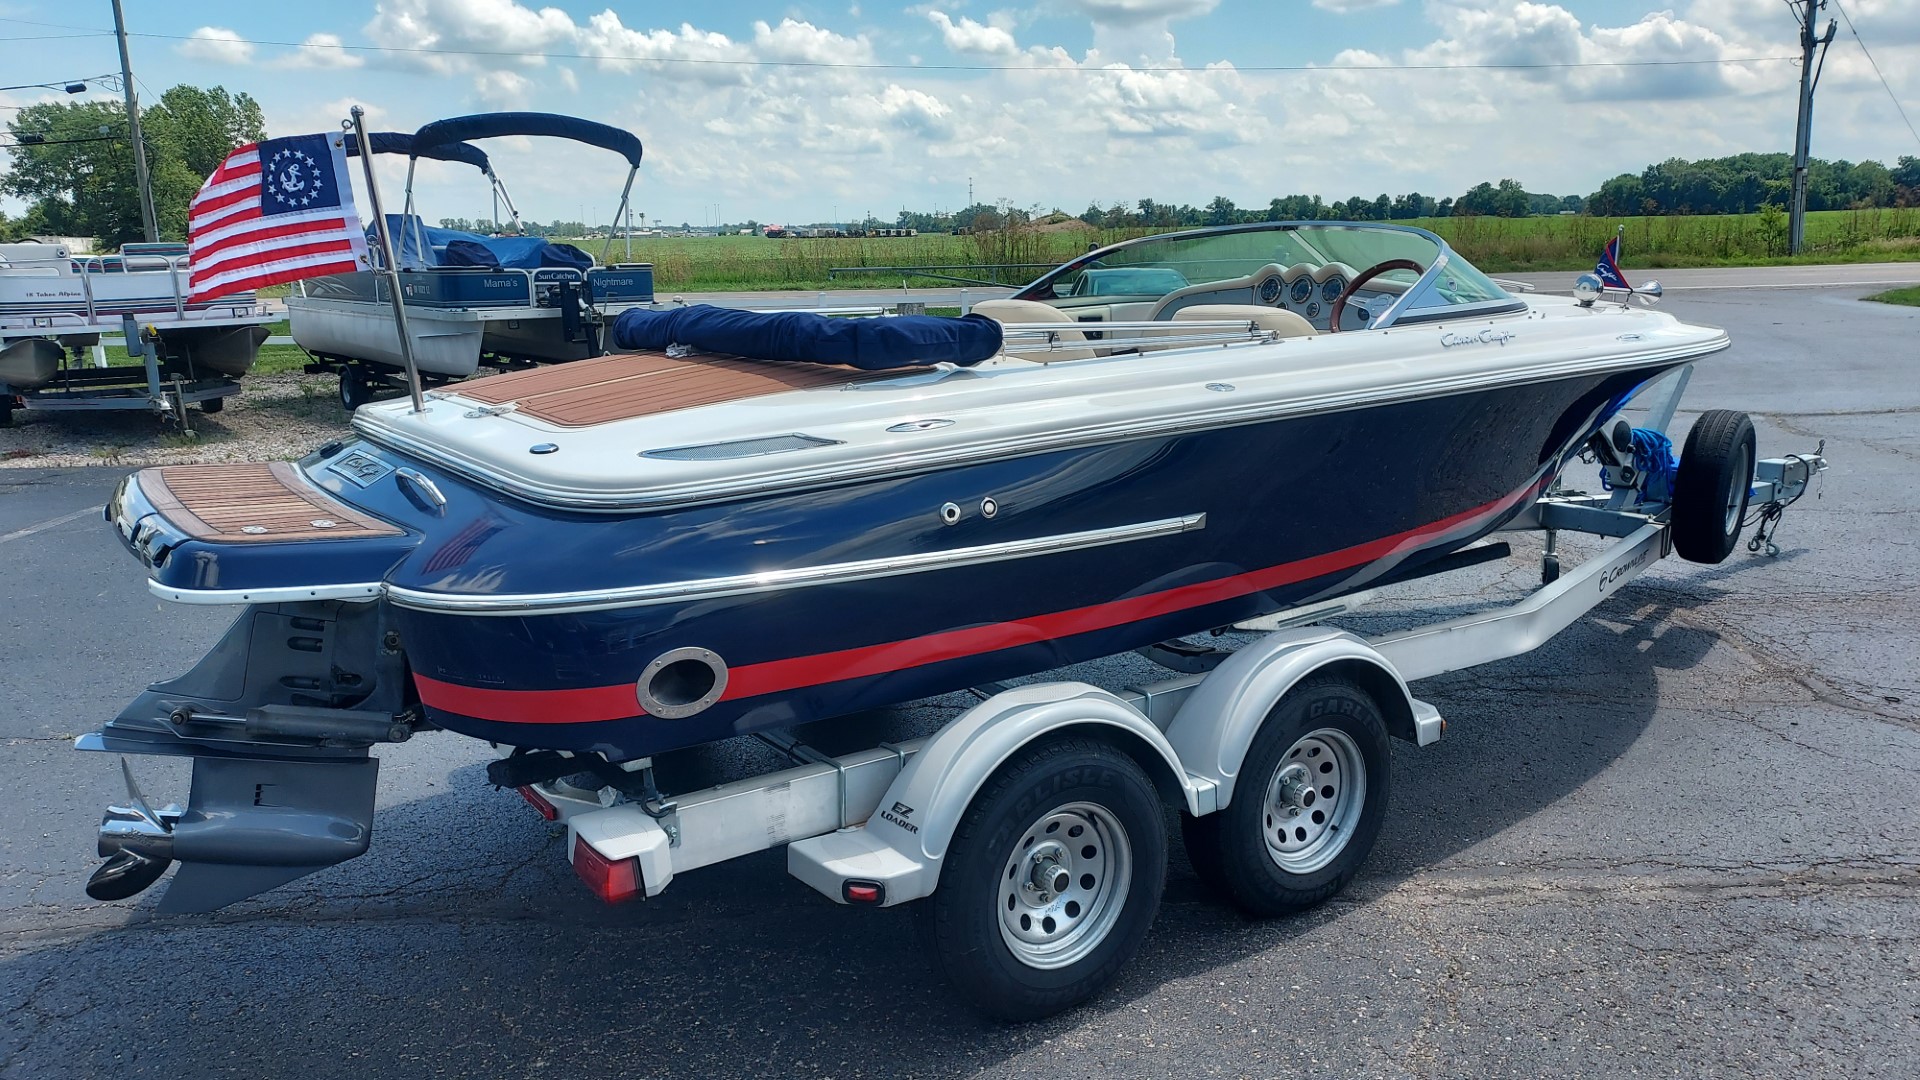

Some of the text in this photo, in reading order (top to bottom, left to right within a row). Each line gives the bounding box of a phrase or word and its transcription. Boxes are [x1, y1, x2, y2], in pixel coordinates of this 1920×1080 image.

[483, 277, 519, 288] Mama's
[593, 277, 634, 288] Nightmare
[891, 801, 915, 820] EZ
[880, 810, 919, 835] LOADER
